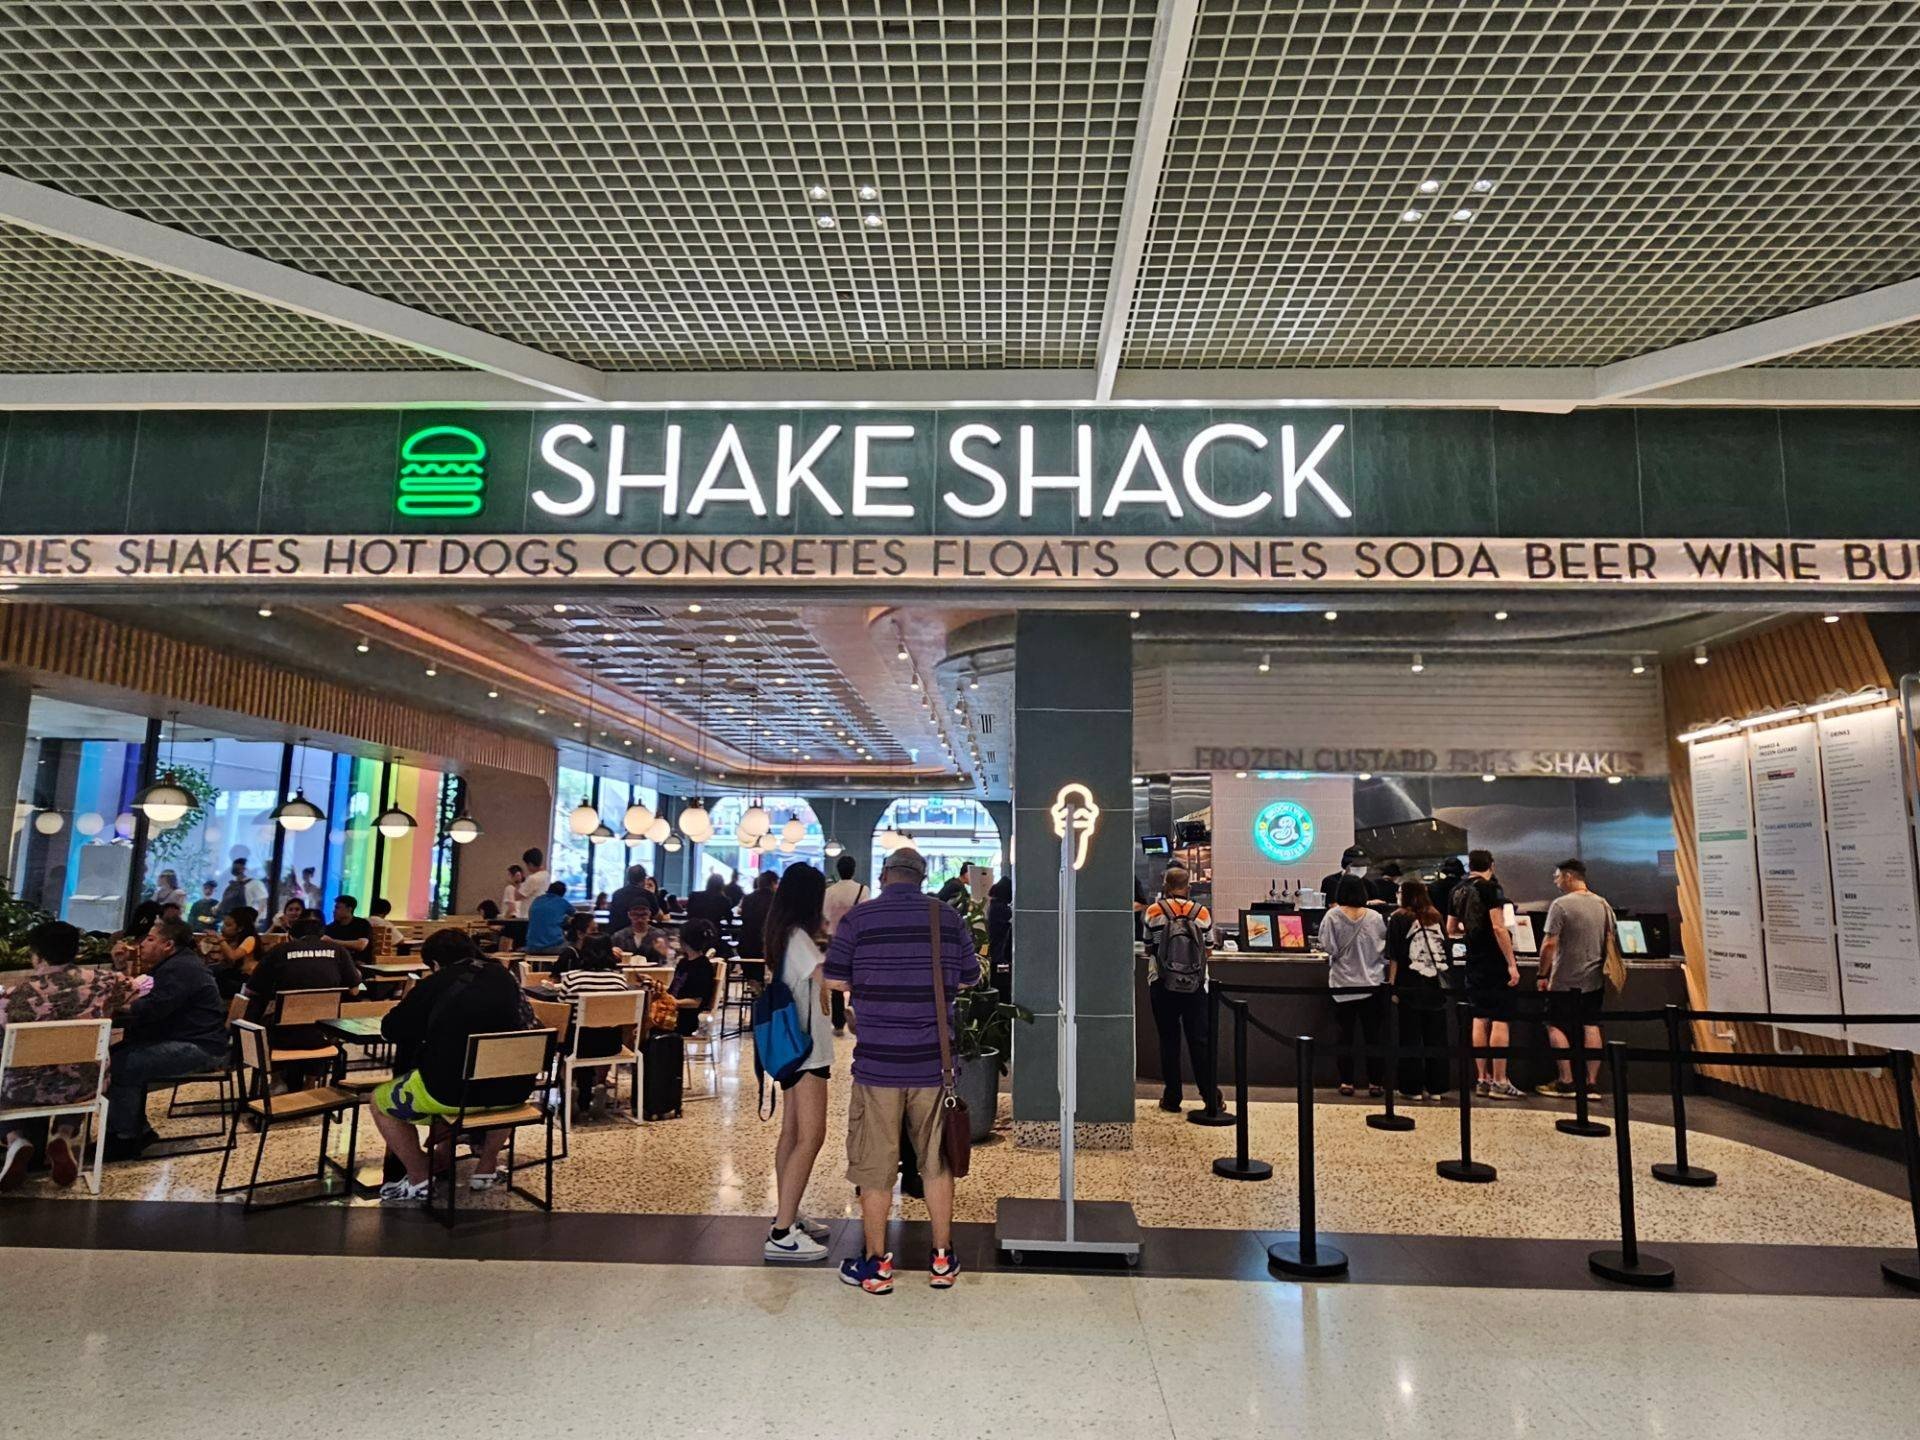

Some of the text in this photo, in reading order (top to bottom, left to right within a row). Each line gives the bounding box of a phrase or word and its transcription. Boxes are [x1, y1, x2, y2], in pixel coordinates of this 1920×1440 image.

[531, 422, 1352, 519] SHAKE SHACK
[115, 538, 300, 575] SHAKES
[323, 538, 428, 575] HOT
[439, 538, 579, 576] DOGS
[604, 539, 907, 577] CONCRETES
[932, 539, 1119, 578] FLOATS
[1145, 540, 1328, 579] CONES
[1355, 541, 1500, 579] SODA
[1525, 542, 1656, 579] BEER
[1683, 541, 1820, 580] WINE
[1843, 543, 1920, 581] BU
[1194, 746, 1304, 770] FROZEN
[1313, 748, 1438, 771] CUSTARD
[287, 949, 335, 959] HUMAN MADE
